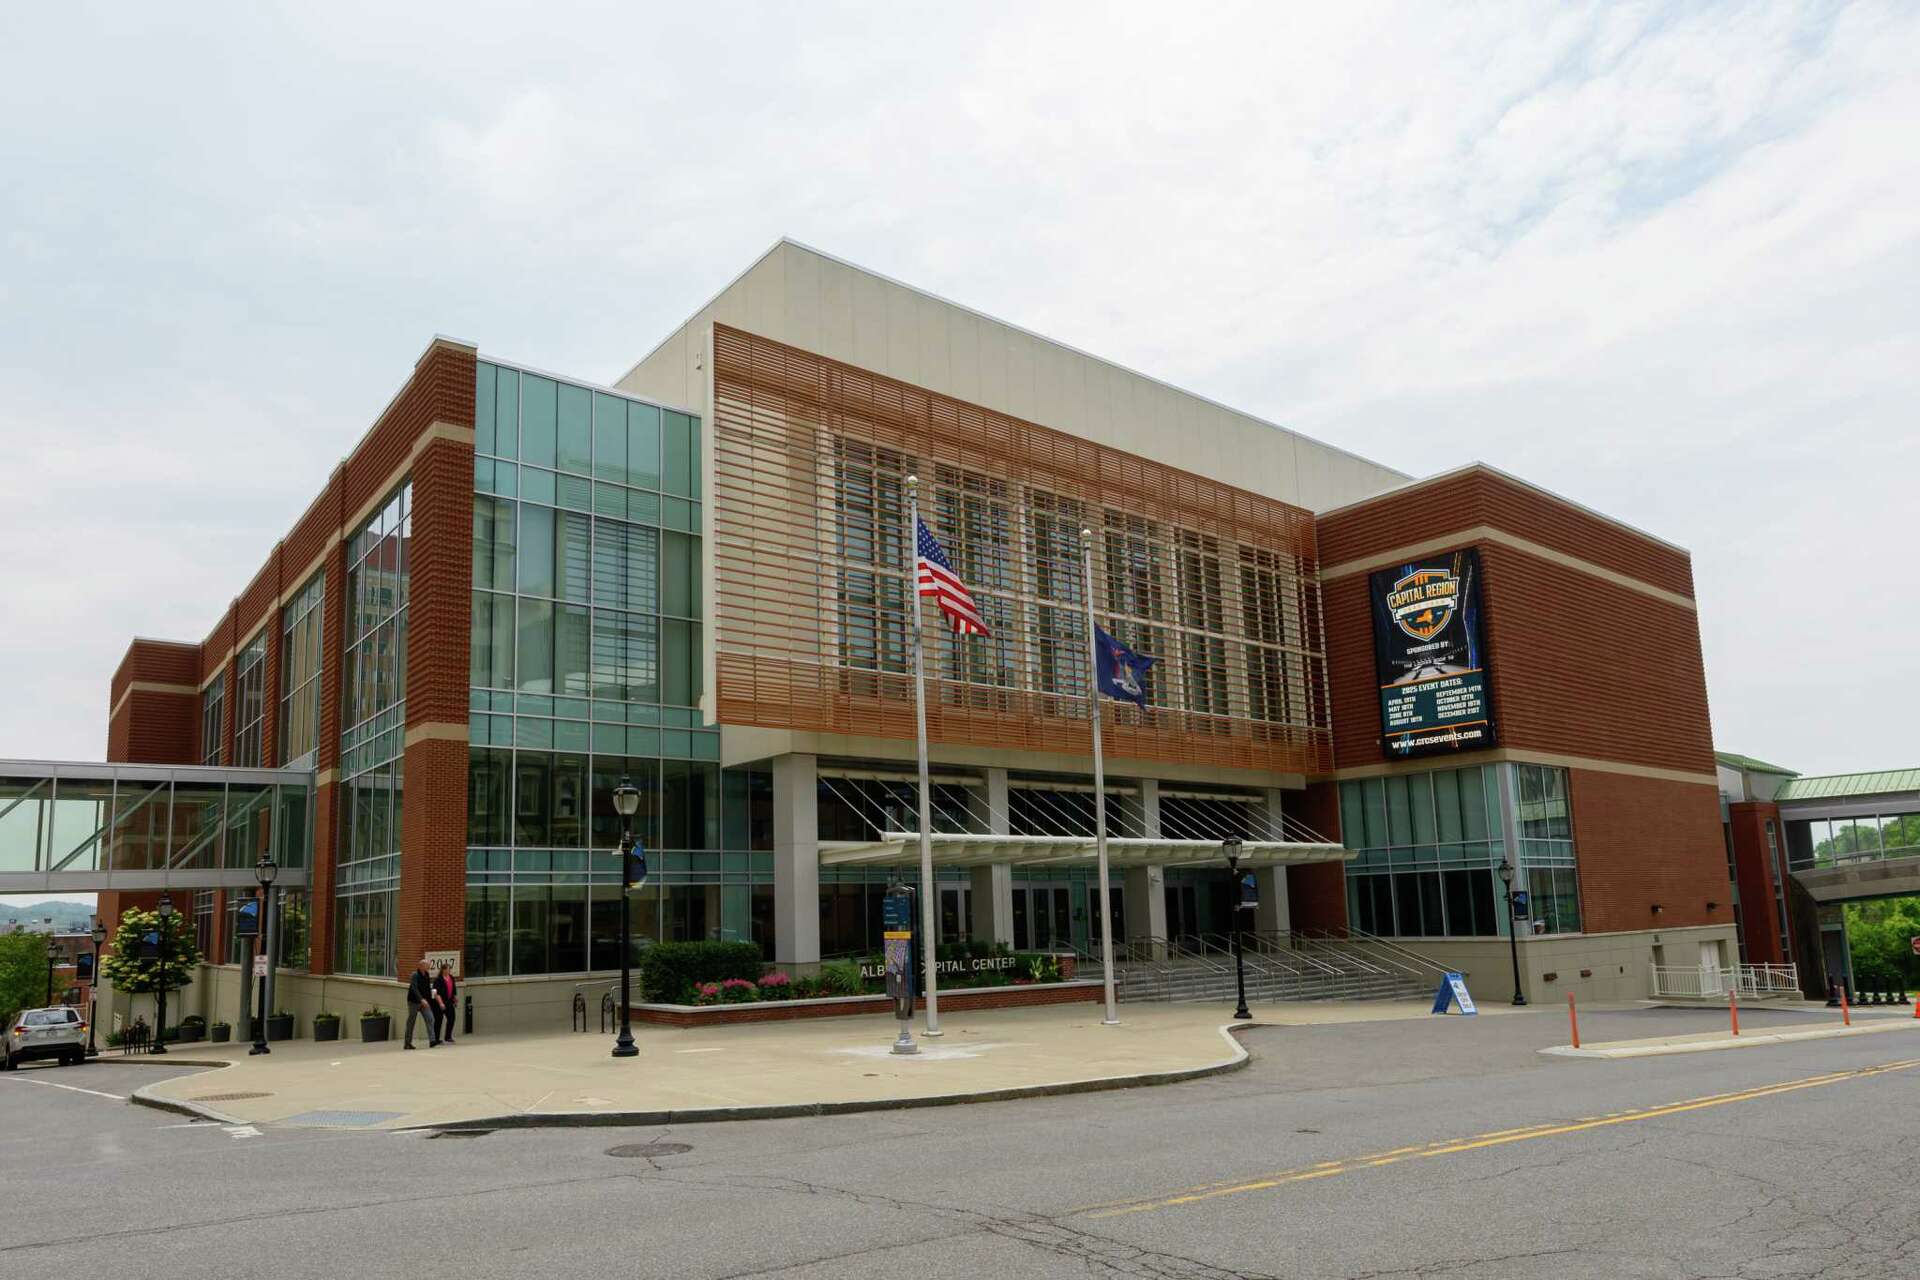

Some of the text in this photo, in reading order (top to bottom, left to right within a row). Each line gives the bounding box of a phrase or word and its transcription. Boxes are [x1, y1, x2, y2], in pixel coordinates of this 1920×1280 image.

[1390, 586, 1424, 608] CAPITAL
[1426, 580, 1456, 598] REGION
[1406, 642, 1440, 654] SPONSORED
[1418, 682, 1439, 692] EVENT
[1440, 678, 1463, 688] DATES:
[1436, 687, 1468, 698] SEPTEMBER
[1388, 698, 1402, 706] APRIL
[1436, 695, 1460, 704] OCTOBER
[1437, 702, 1466, 712] NOVEMBER
[1389, 712, 1402, 720] JUNE
[1437, 709, 1466, 719] DECEMBER
[1390, 718, 1409, 726] AUGUST
[972, 957, 1016, 970] CENTER
